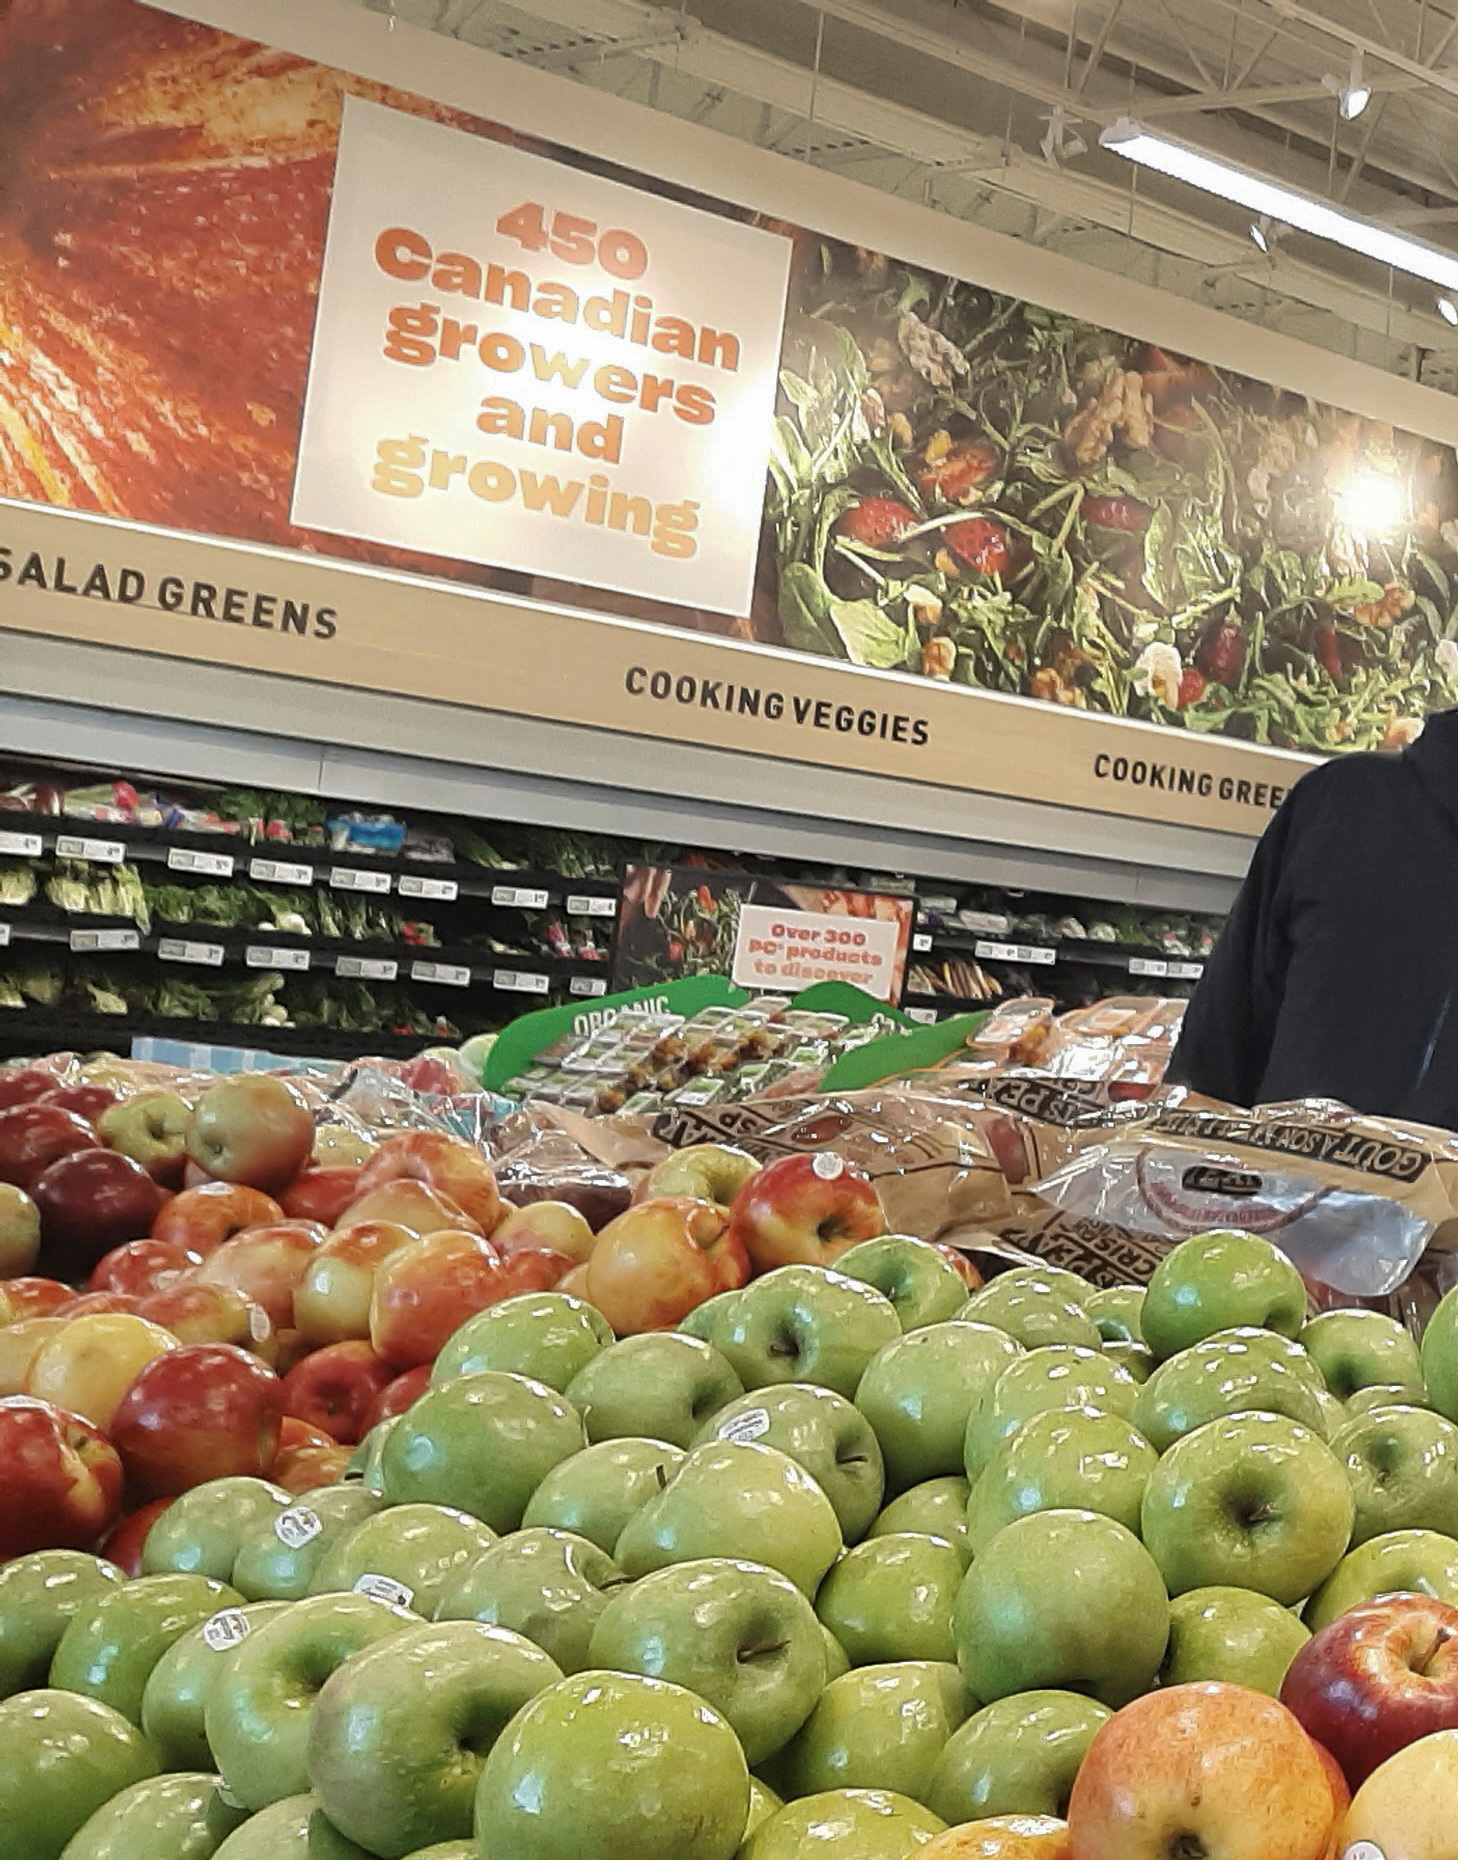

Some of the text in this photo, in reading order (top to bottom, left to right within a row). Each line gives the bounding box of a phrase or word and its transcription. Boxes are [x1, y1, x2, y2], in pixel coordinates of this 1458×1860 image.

[495, 201, 649, 280] 450
[374, 226, 742, 373] Canadian
[381, 302, 717, 426] growers
[475, 395, 626, 465] and
[369, 433, 702, 561] growing
[0, 547, 338, 640] SALAD GREENS
[625, 666, 930, 746] COOKING VEGGIES
[1094, 753, 1292, 809] COOKING GREE
[754, 959, 874, 986] to discover
[771, 923, 867, 947] Over 300
[786, 945, 883, 967] products
